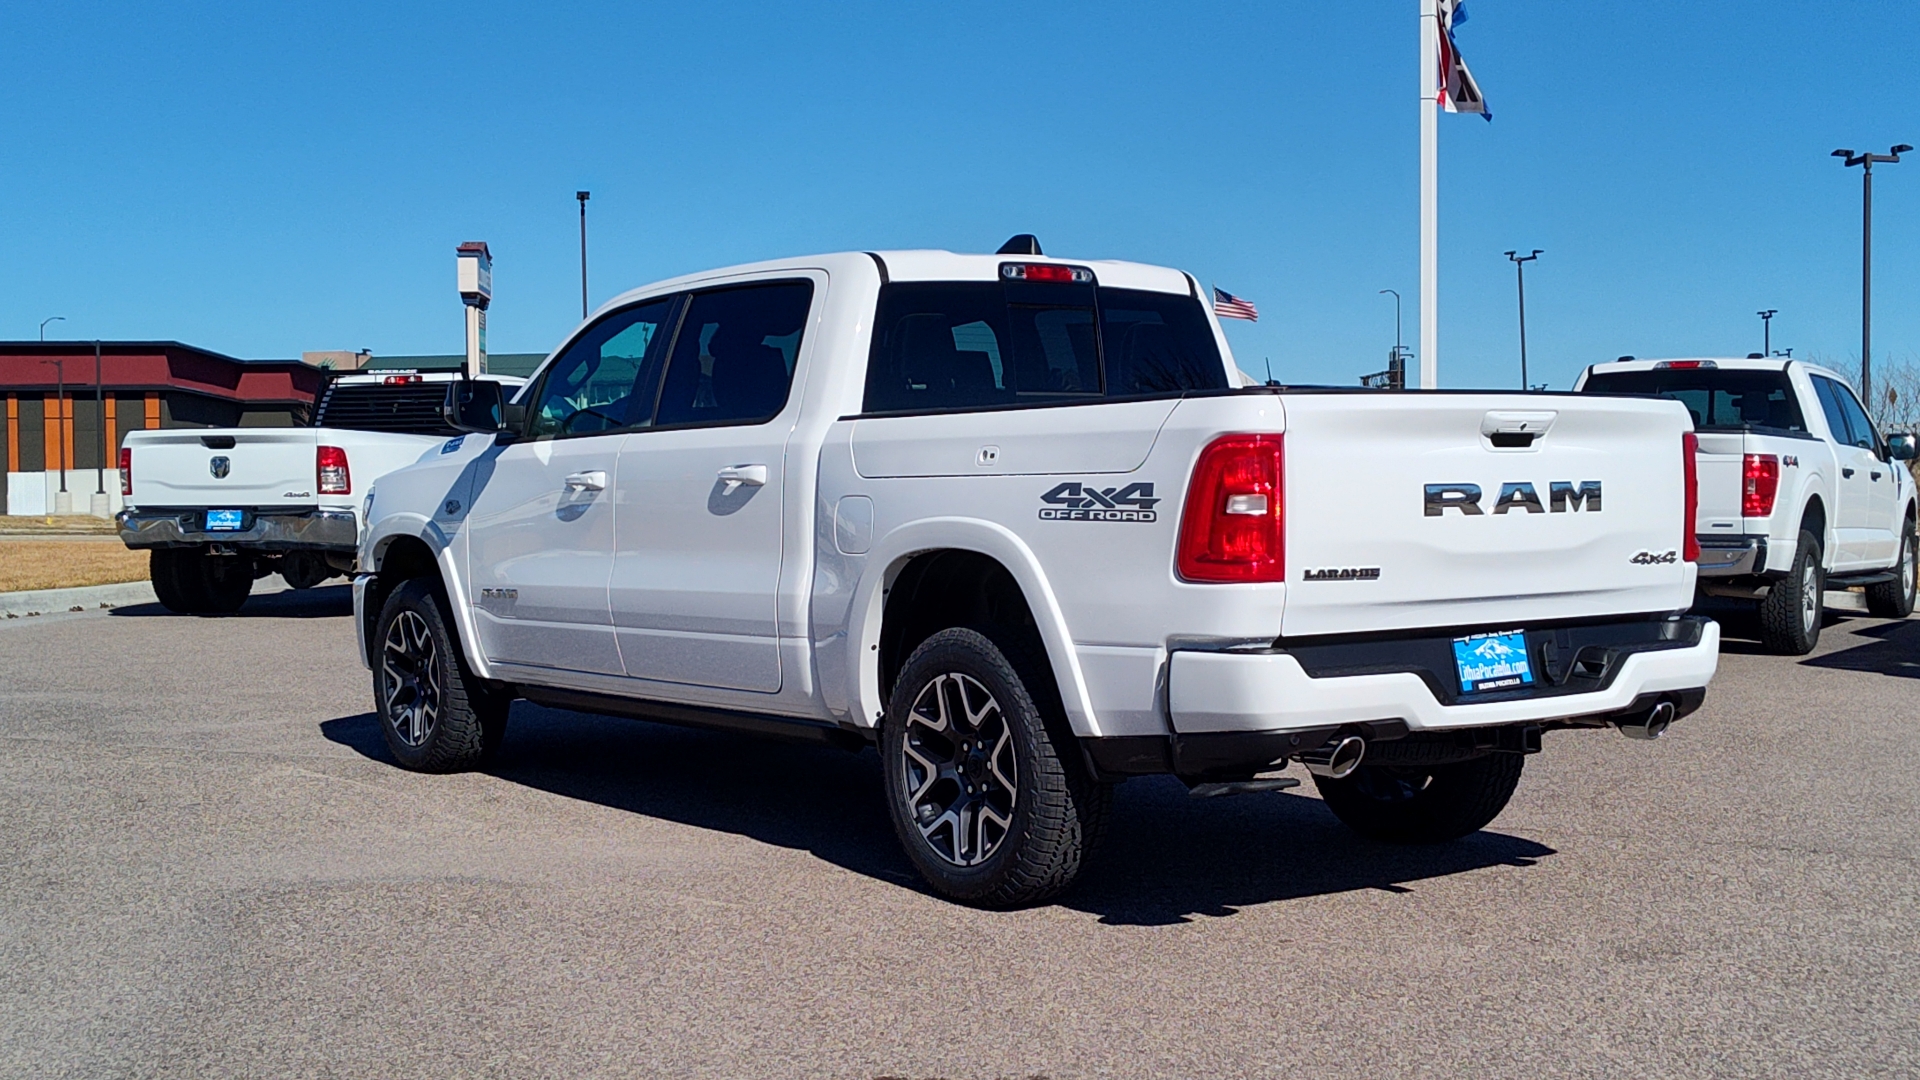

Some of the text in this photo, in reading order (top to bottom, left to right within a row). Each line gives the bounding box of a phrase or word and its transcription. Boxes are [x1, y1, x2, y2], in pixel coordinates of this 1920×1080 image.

[1423, 481, 1602, 517] RAM
[1040, 509, 1155, 521] OFF ROAD
[1303, 567, 1380, 580] LARAMIE
